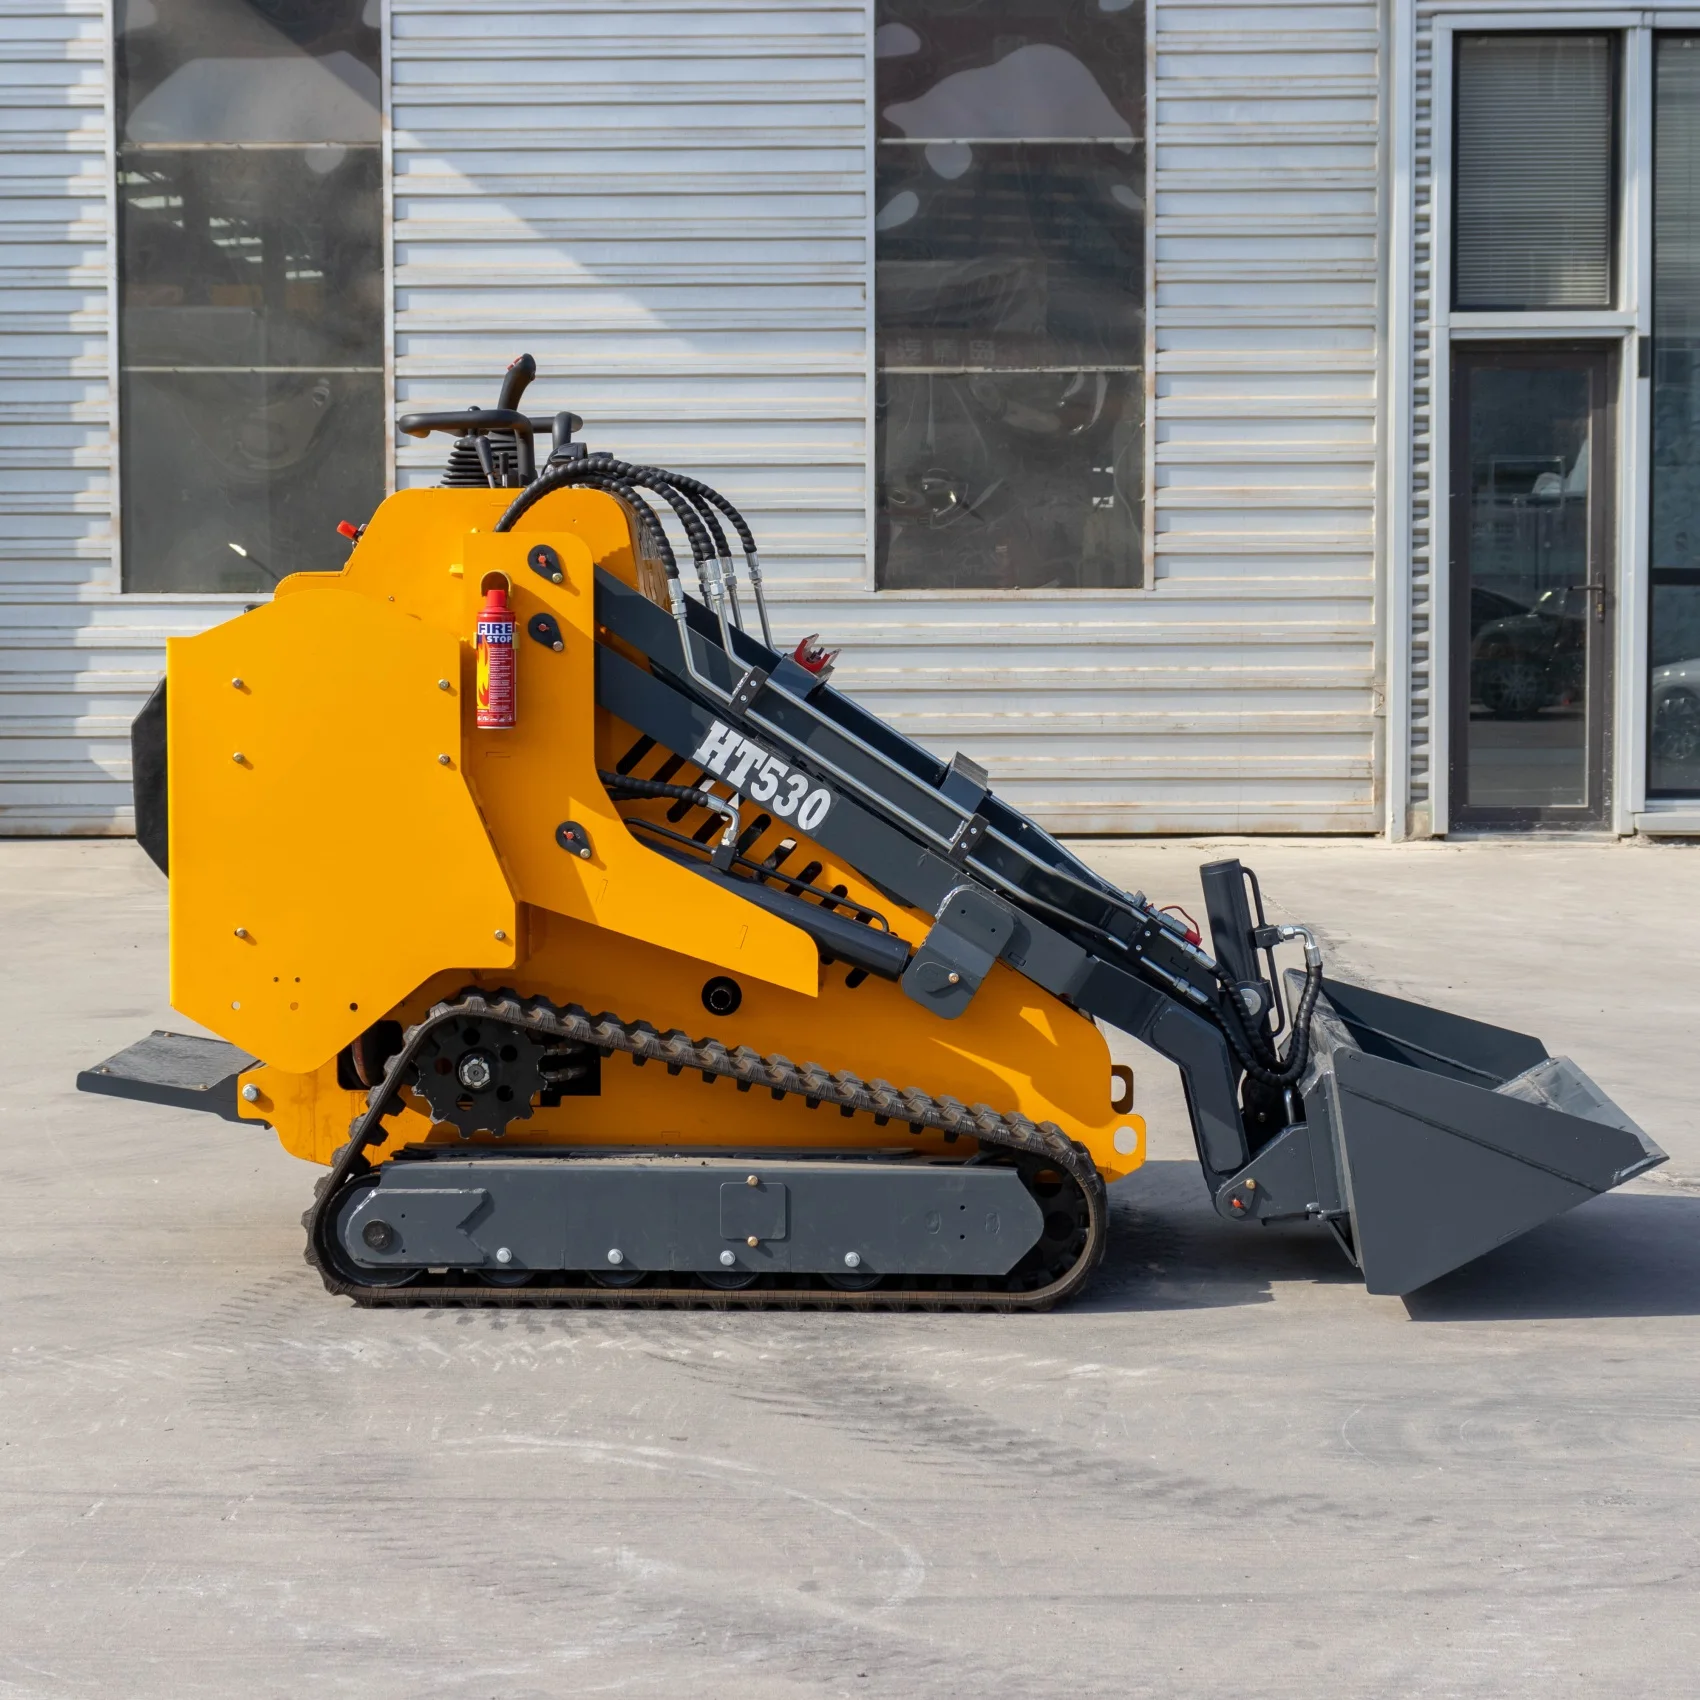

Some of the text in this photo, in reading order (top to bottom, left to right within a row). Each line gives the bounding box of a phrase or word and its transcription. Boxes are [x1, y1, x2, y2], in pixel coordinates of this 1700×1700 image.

[478, 623, 512, 634] FIRE
[486, 635, 512, 643] STOP
[692, 720, 831, 831] HT530
